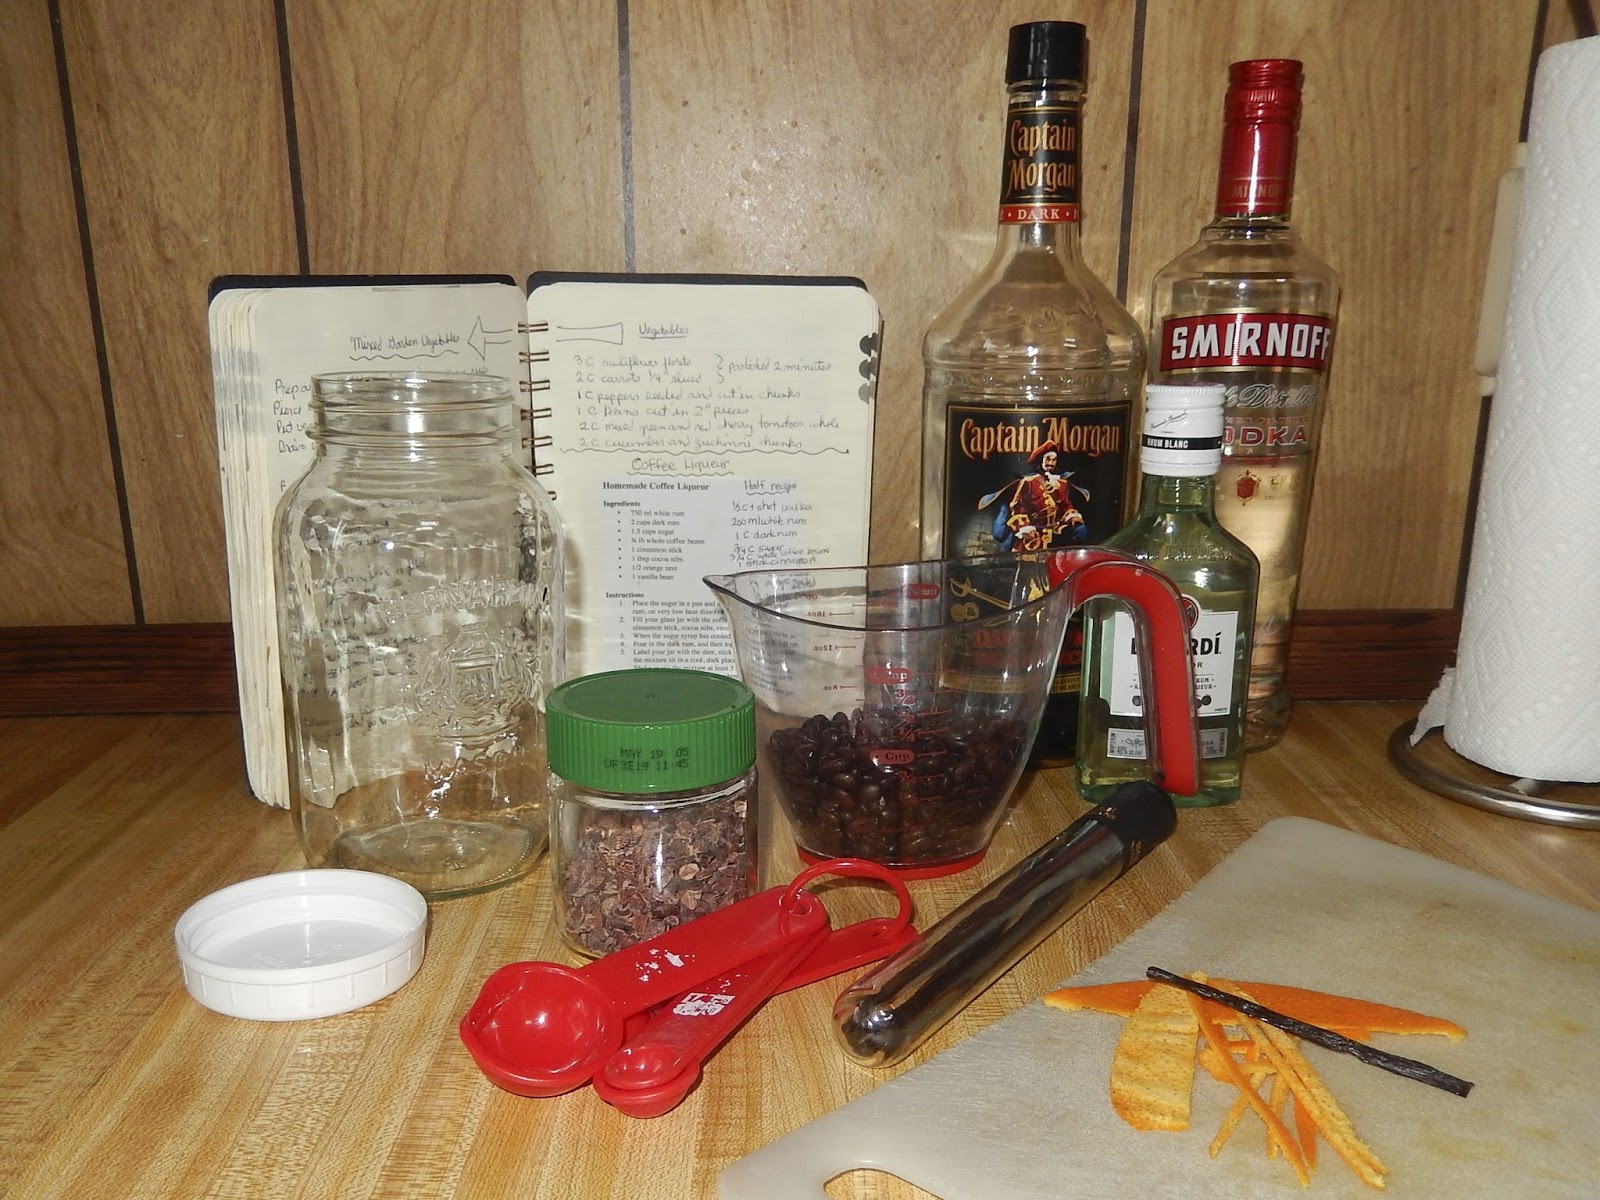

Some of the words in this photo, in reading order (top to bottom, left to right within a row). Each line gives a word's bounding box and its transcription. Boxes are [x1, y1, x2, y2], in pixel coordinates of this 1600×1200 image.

[1010, 118, 1075, 157] Captain
[1004, 158, 1075, 199] Morgan
[1017, 209, 1060, 220] DARK
[638, 322, 689, 340] Vegetables
[350, 335, 383, 352] Mixed
[421, 331, 461, 353] Vegetables
[1171, 322, 1332, 361] SMIRNOFF
[574, 355, 583, 366] 3
[773, 362, 783, 371] 2
[785, 360, 832, 372] minutes
[576, 372, 584, 383] 2
[601, 372, 641, 383] carrots
[597, 391, 641, 406] peppers
[688, 388, 713, 400] and
[718, 387, 739, 399] cut
[739, 387, 753, 400] in
[759, 386, 801, 399] chunks
[604, 404, 639, 418] beans
[646, 404, 669, 417] cut
[670, 402, 689, 416] in
[713, 405, 749, 418] pieces
[579, 422, 590, 432] 2
[605, 420, 634, 431] mixed
[694, 420, 713, 432] red
[718, 417, 754, 437] cherry
[757, 414, 804, 430] tomatoes
[809, 414, 840, 429] whole
[605, 437, 665, 447] cucumber
[667, 436, 690, 447] and
[760, 434, 802, 448] chunks
[960, 417, 1039, 460] Captain
[1042, 416, 1120, 459] Morgan
[1164, 438, 1189, 449] BLANC
[631, 457, 677, 471] Coffee
[684, 457, 730, 472] Liqueur
[603, 481, 648, 491] Homemade
[649, 482, 675, 491] Coffee
[677, 482, 710, 492] Liqueur
[744, 480, 766, 491] Half
[770, 482, 797, 494] recipe
[603, 500, 641, 508] Ingredients
[756, 500, 776, 512] shot
[630, 509, 642, 517] 750
[731, 517, 747, 527] 200
[787, 517, 807, 526] rum
[657, 529, 675, 537] sugar
[743, 530, 750, 539] C
[754, 529, 776, 539] dark
[758, 544, 785, 555] sugar
[807, 547, 830, 556] beans
[637, 555, 650, 563] tbsp
[676, 616, 685, 624] jar
[620, 747, 642, 759] MAY
[650, 749, 663, 759] 19
[676, 747, 689, 758] 05
[603, 758, 649, 771] UF3E19
